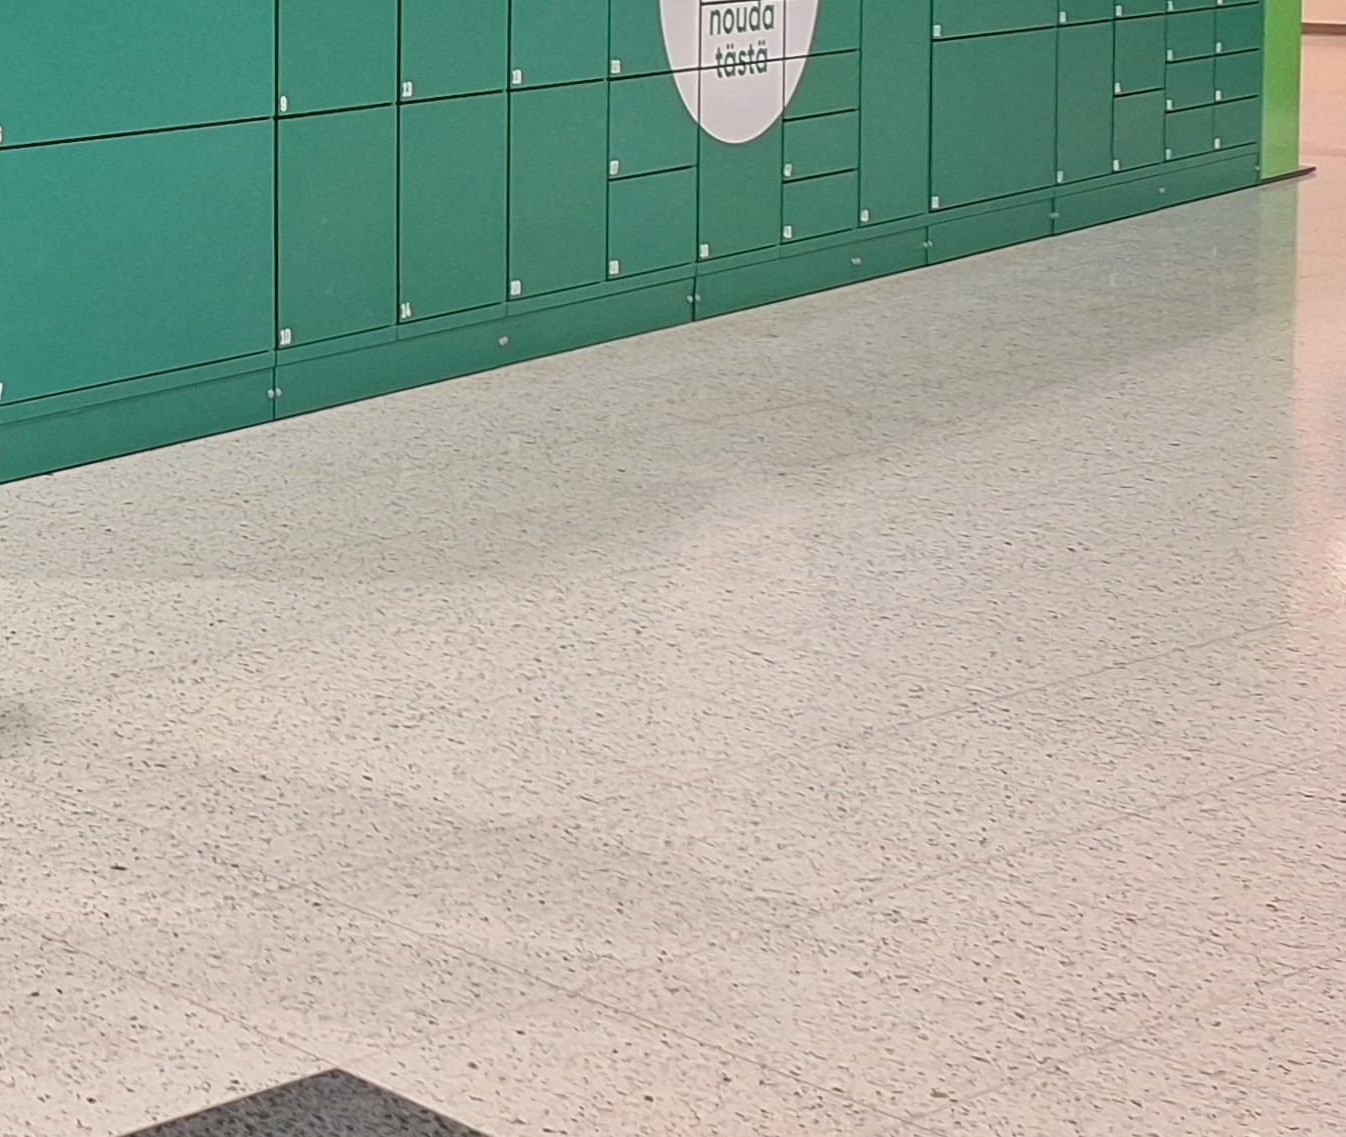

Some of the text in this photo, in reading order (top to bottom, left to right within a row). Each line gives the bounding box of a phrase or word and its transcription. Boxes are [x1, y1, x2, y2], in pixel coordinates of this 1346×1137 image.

[715, 40, 768, 79] tästä
[401, 81, 413, 98] 13
[280, 95, 288, 113] 9
[400, 302, 412, 319] 14
[279, 328, 292, 346] 10
